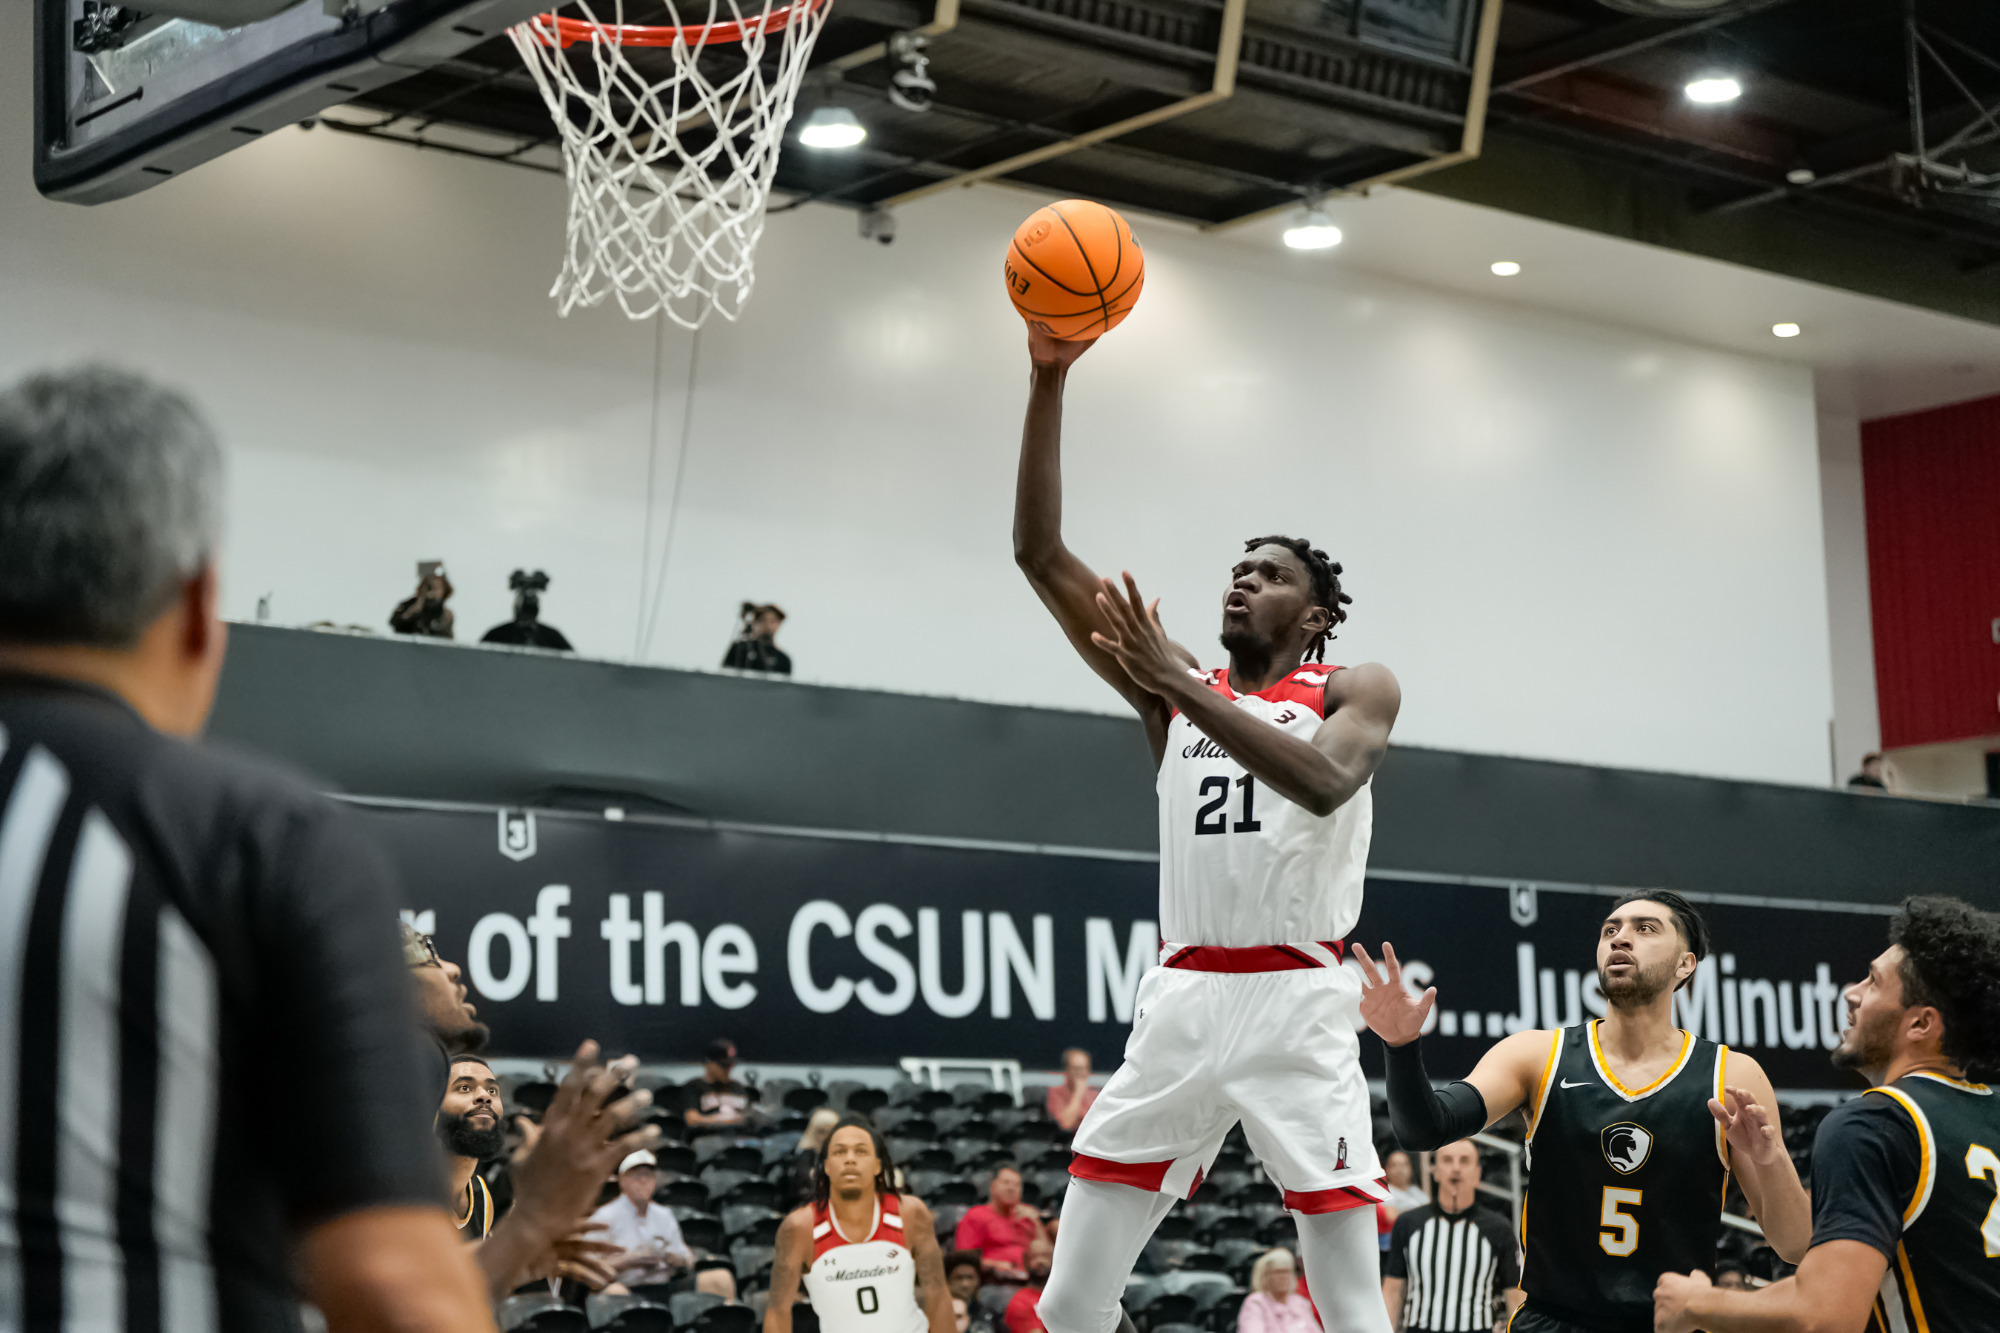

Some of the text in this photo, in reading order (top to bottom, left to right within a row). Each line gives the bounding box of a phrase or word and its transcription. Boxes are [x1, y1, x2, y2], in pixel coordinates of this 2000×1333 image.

[1195, 774, 1261, 835] 21
[467, 885, 571, 1002] of
[601, 891, 758, 1009] the
[787, 900, 1056, 1021] CSUN
[1599, 1185, 1643, 1257] 5
[856, 1286, 879, 1315] 0
